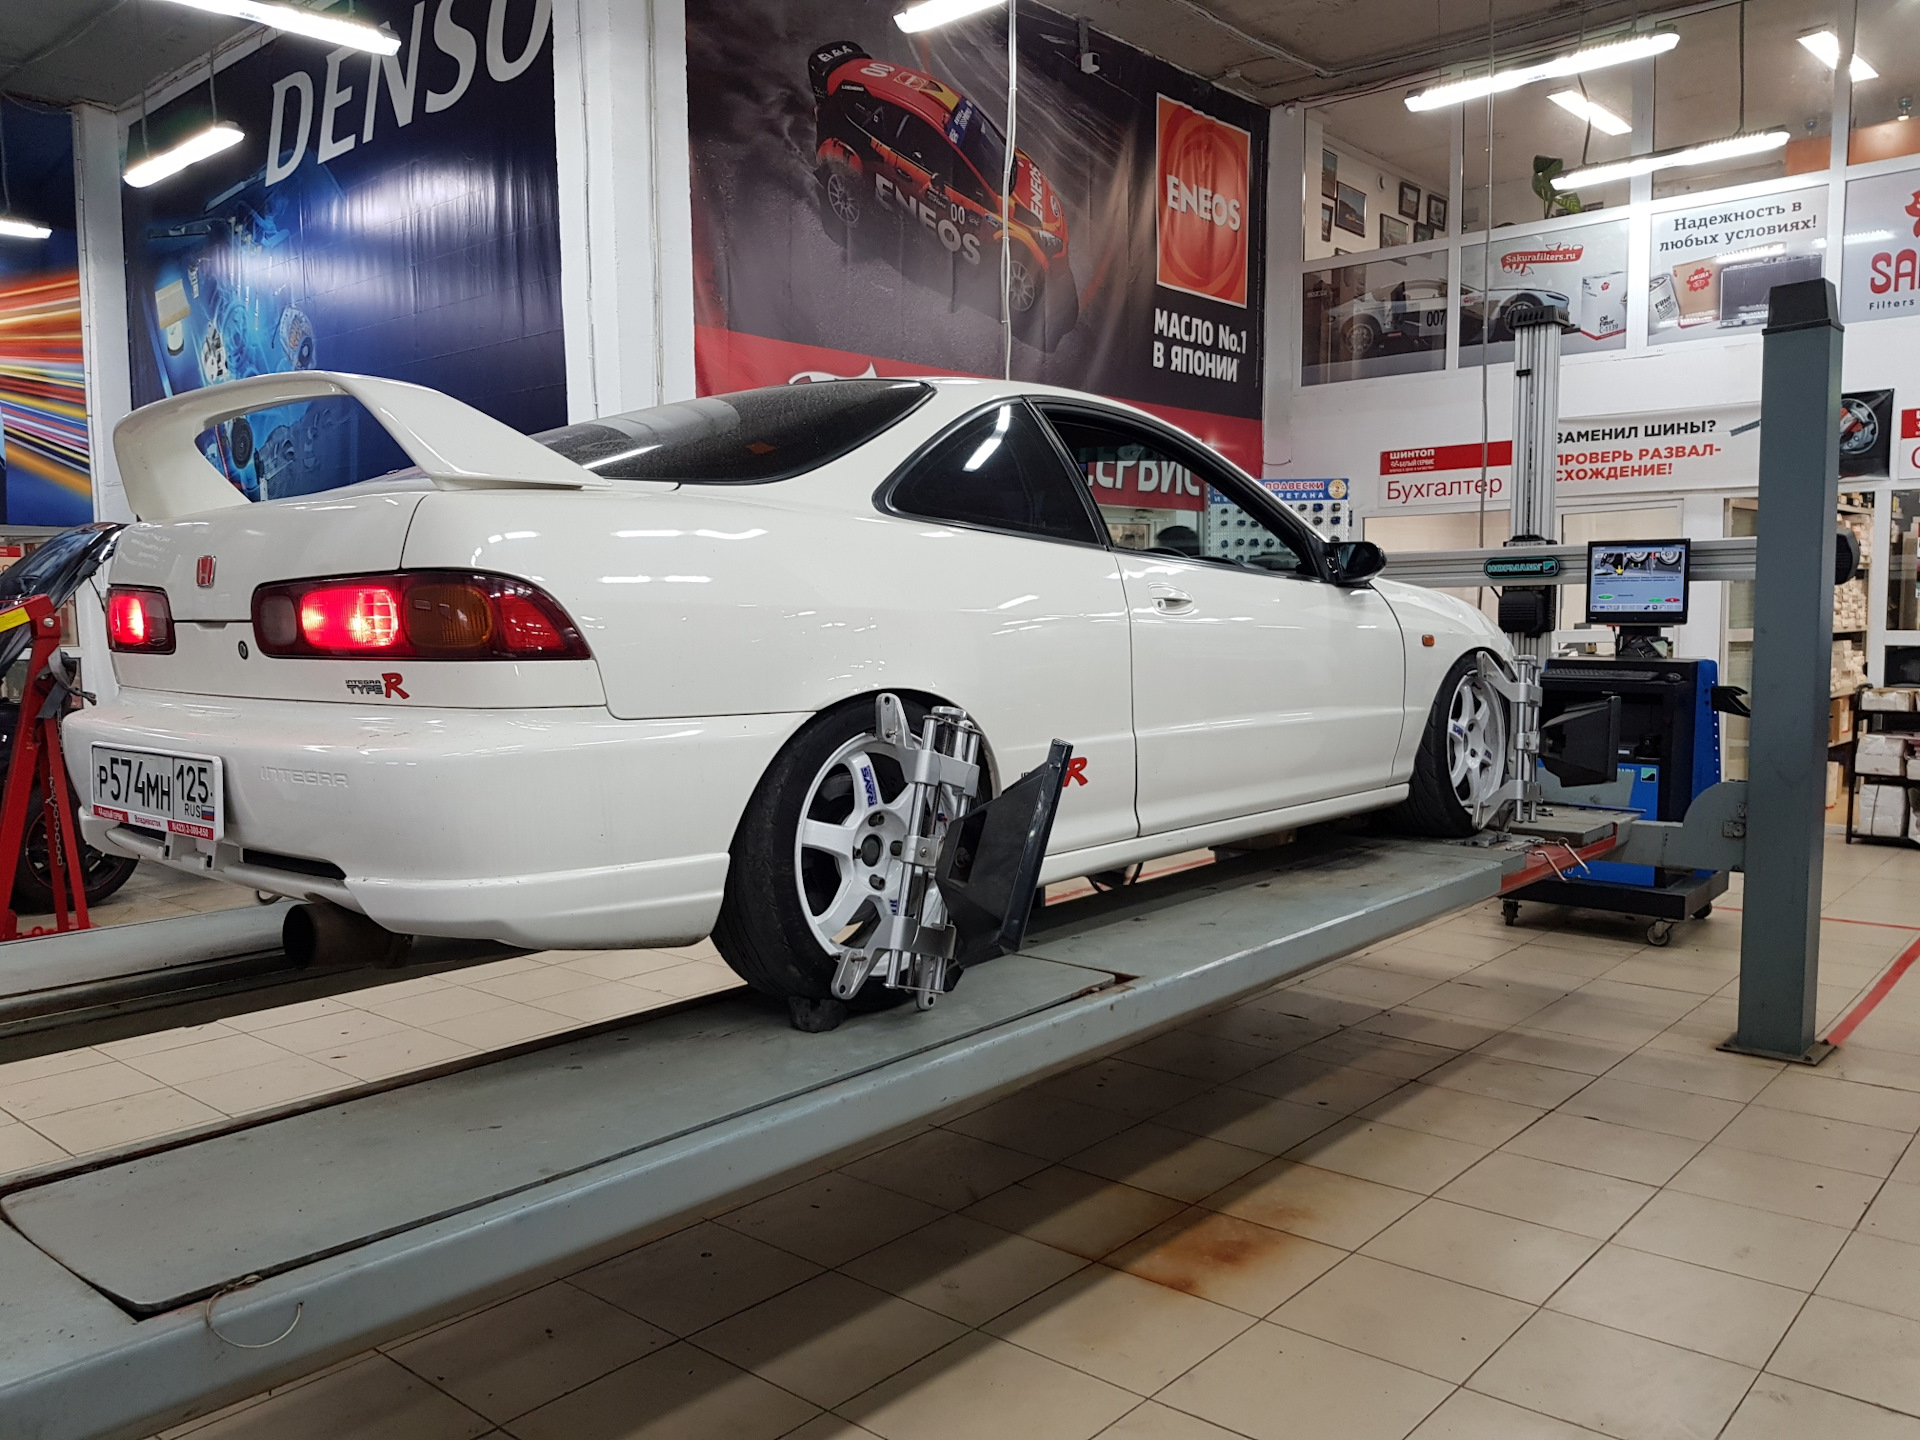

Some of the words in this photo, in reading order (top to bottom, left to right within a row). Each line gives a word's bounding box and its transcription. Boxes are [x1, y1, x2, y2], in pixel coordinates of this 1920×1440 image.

[265, 0, 551, 187] DENSO
[1030, 164, 1044, 222] ENEOS
[1167, 174, 1241, 232] ENEOS
[875, 172, 981, 265] ENEOS
[950, 203, 965, 225] 00
[1674, 204, 1786, 232] Надежность
[1791, 201, 1802, 212] в
[1659, 234, 1719, 252] любых
[1725, 214, 1817, 245] условиях!
[1505, 252, 1576, 264] Sakurafilters.ru
[1869, 298, 1914, 310] Filters
[1154, 307, 1214, 347] МАСЛО
[1218, 323, 1247, 354] No.1
[1426, 310, 1446, 327] 007
[1152, 340, 1165, 369] В
[1170, 345, 1238, 383] ЯПОНИИ
[1557, 426, 1638, 443] ЗАМЕНИЛ
[1644, 419, 1717, 438] ШИНЫ?
[1389, 448, 1435, 460] ШИНТОП
[1638, 444, 1721, 460] РАЗВАЛ-
[1264, 481, 1324, 491] ПОДВЕСКИ
[1387, 477, 1502, 504] Бухгалтер
[346, 684, 384, 695] TYPE
[381, 672, 410, 699] R
[98, 756, 171, 812] Р574МН
[176, 762, 209, 804] 125
[261, 766, 349, 788] INTEGRA
[1063, 757, 1088, 787] R
[185, 803, 201, 818] RUS
